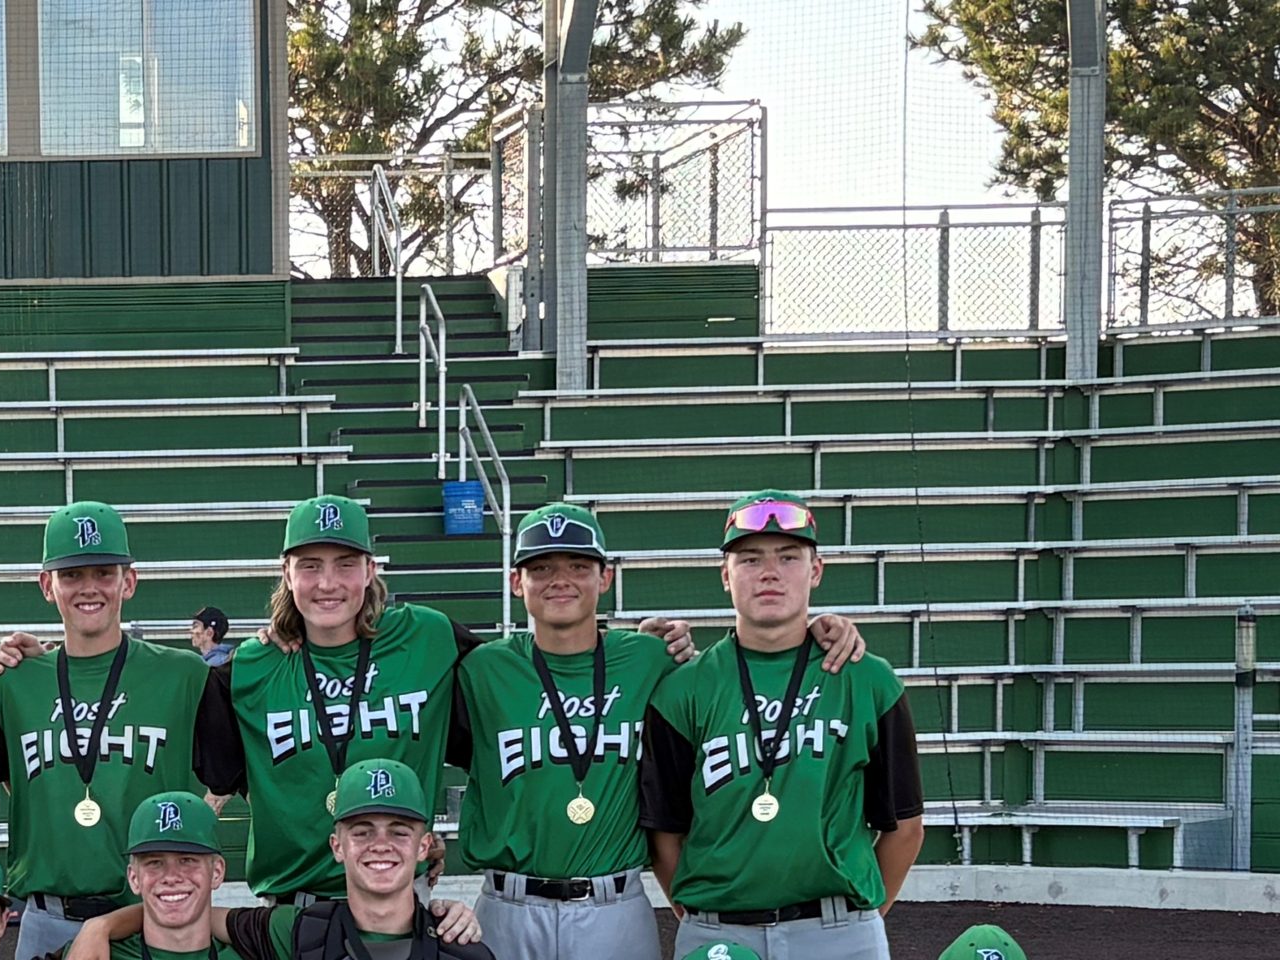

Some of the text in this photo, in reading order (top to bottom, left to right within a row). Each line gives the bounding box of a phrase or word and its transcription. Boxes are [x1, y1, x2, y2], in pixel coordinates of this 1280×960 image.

[266, 690, 428, 766] EIGHT
[538, 685, 621, 719] Post
[20, 725, 167, 782] EIGHT
